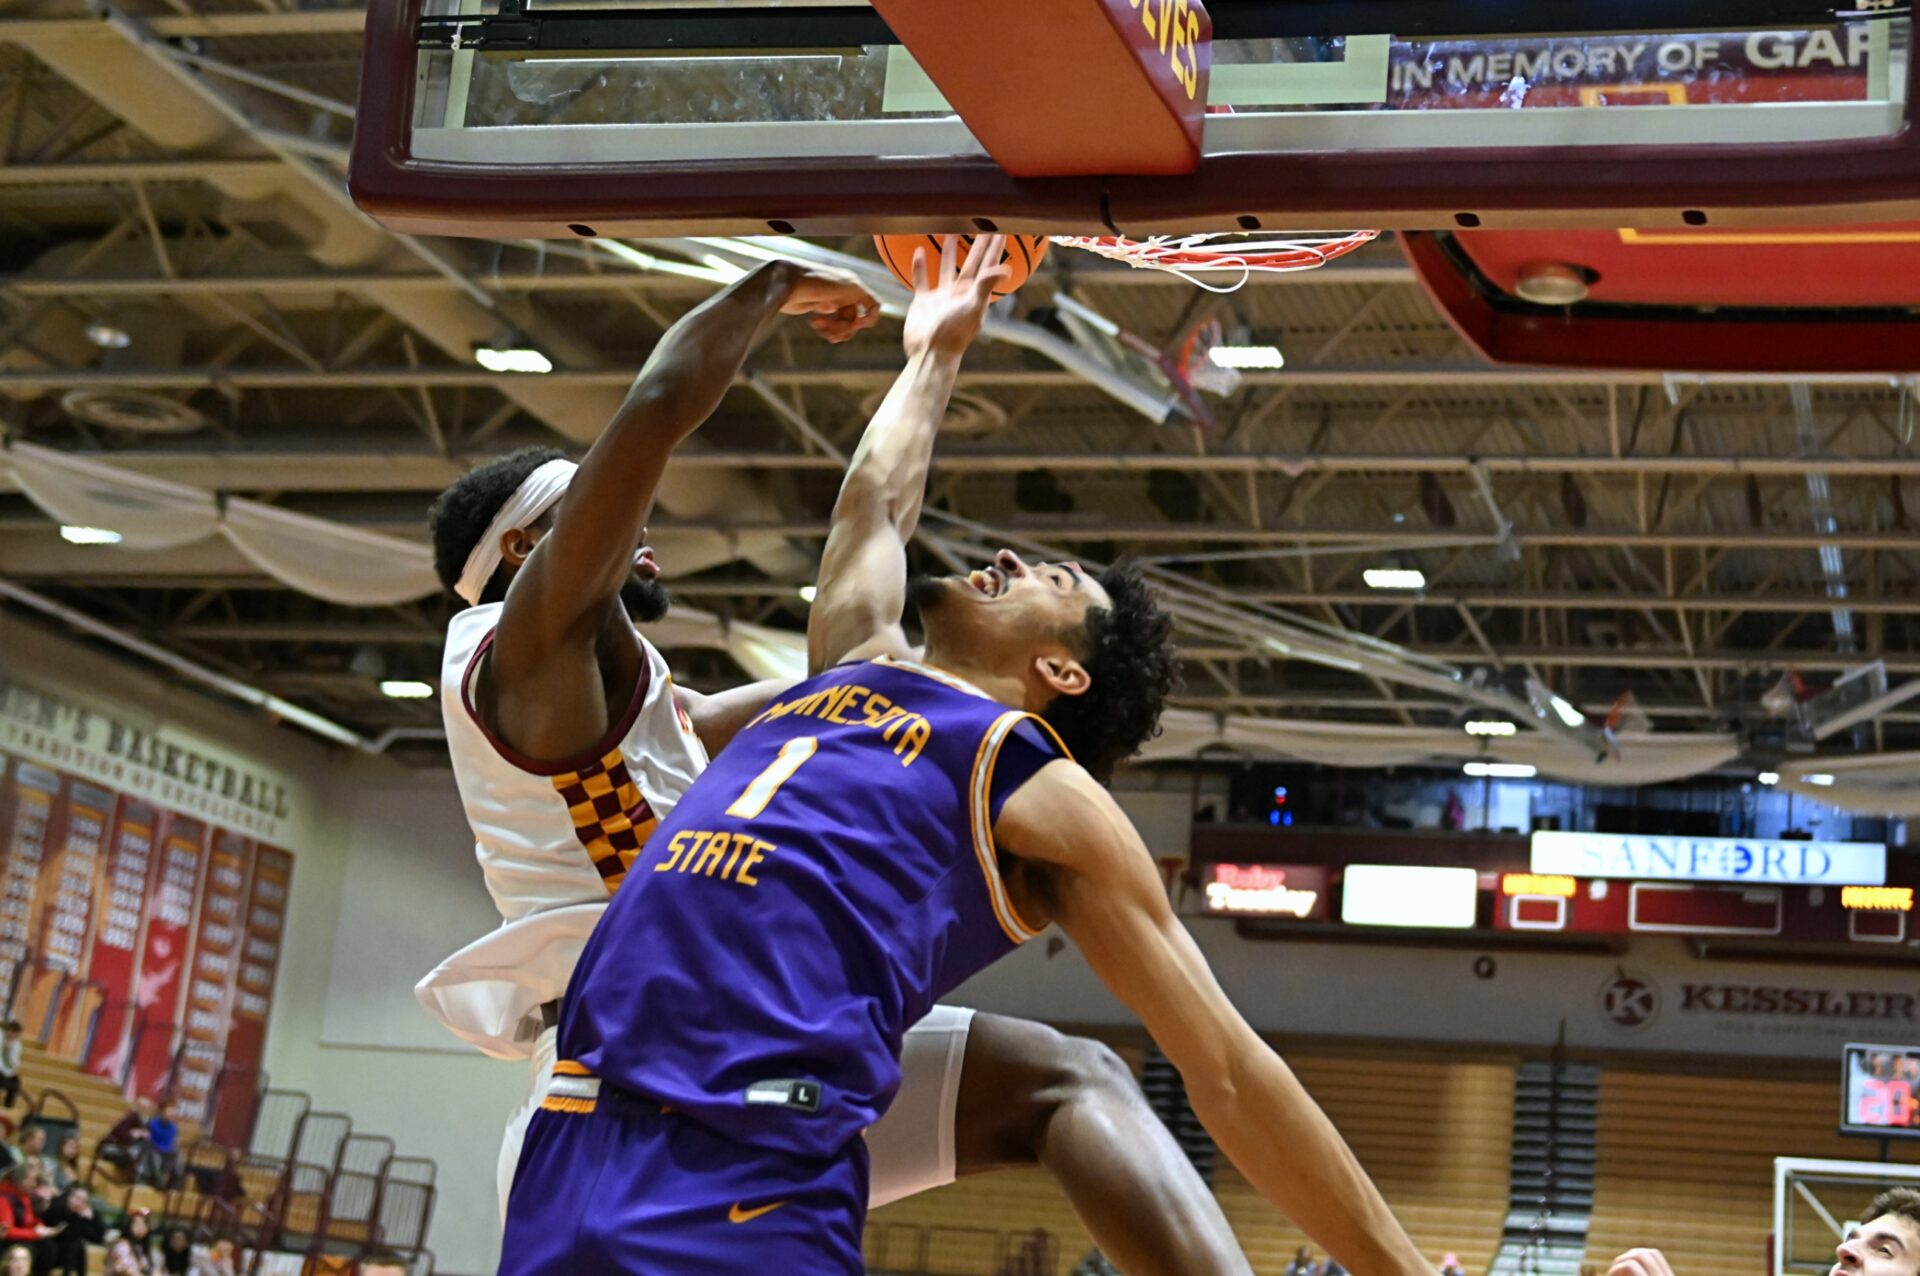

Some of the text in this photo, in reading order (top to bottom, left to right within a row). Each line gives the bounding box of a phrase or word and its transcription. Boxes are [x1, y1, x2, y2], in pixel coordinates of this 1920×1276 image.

[1391, 62, 1433, 92] IN
[1449, 44, 1646, 85] MEMORY
[1657, 39, 1720, 72] OF
[106, 719, 290, 819] BASKETBALL
[724, 736, 818, 819] 1
[654, 830, 777, 887] STATE
[1582, 839, 1832, 879] SANFORD
[798, 1087, 809, 1102] L
